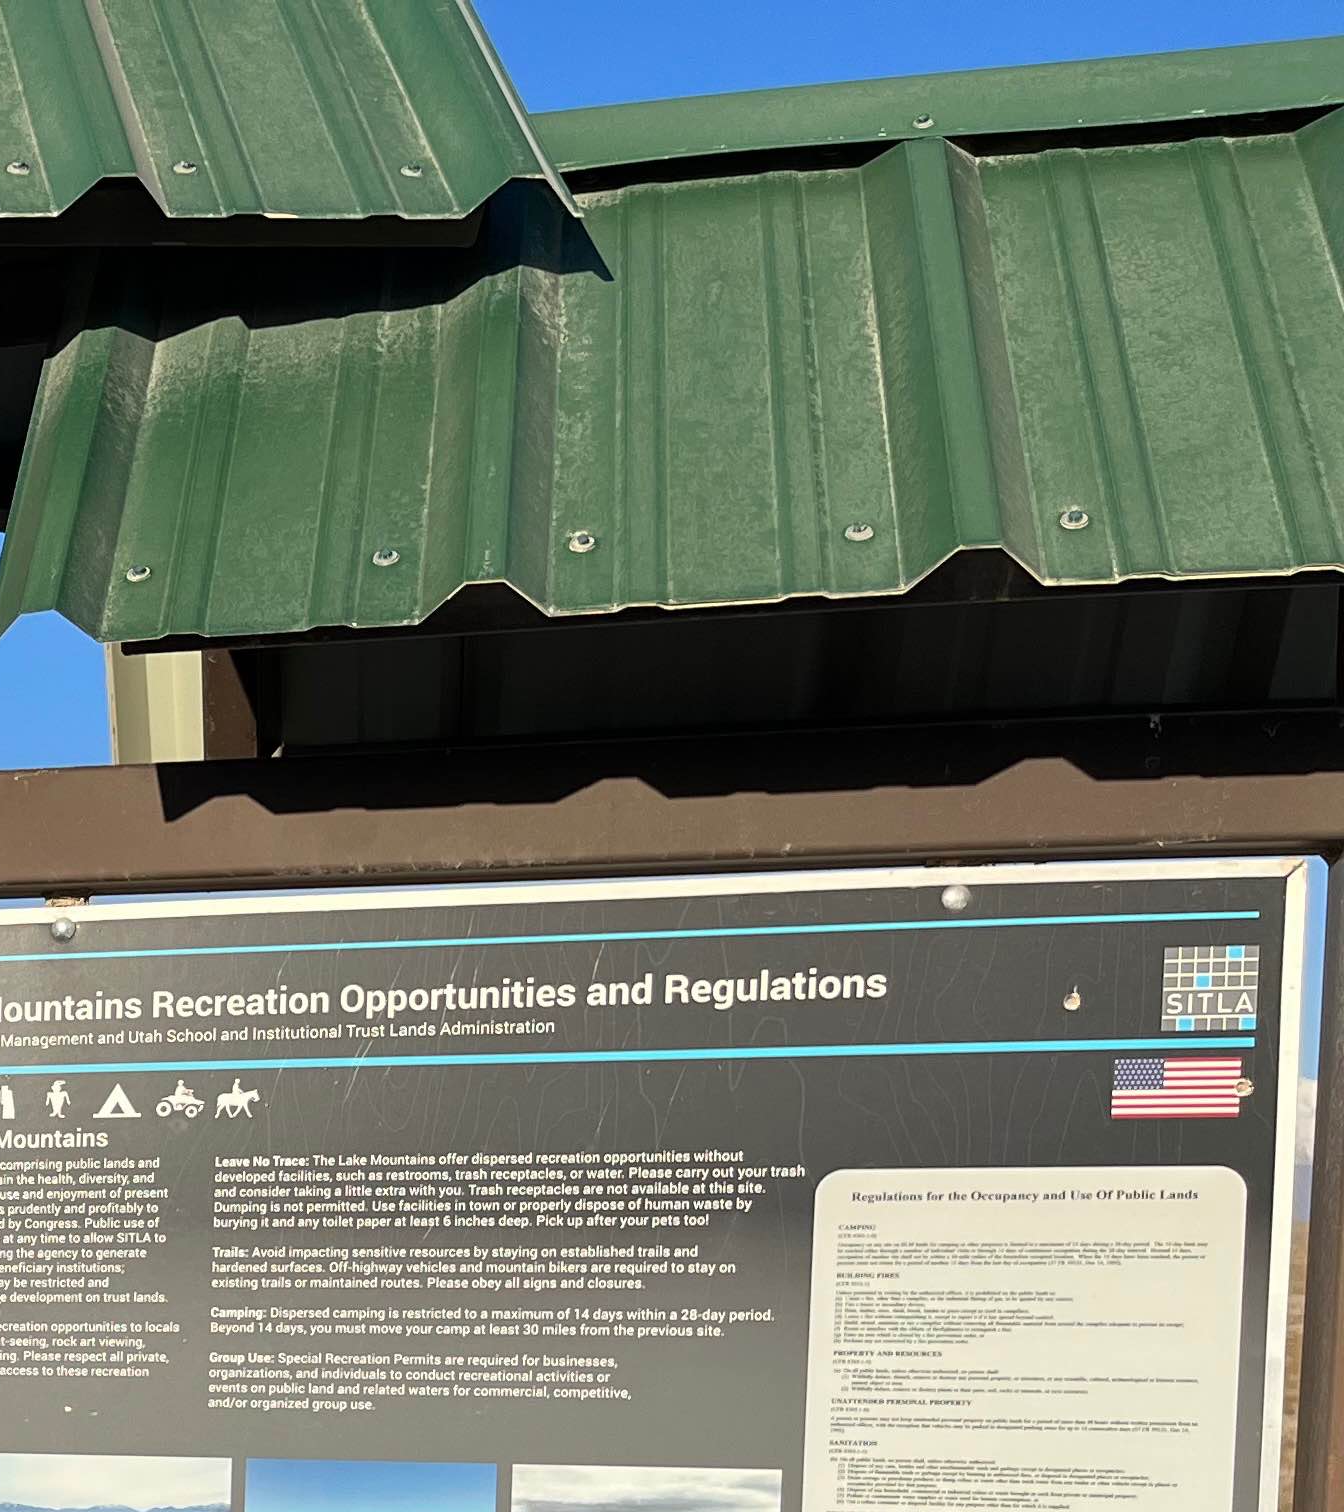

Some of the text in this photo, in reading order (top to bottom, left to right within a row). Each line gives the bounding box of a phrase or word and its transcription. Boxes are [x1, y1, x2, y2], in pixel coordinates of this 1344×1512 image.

[153, 985, 329, 1018] Recreation
[341, 975, 575, 1017] Opportunities
[587, 972, 652, 1006] and
[665, 967, 886, 1009] Regulations
[1166, 992, 1254, 1016] SITLA
[1, 1032, 93, 1049] Management
[98, 1030, 124, 1045] and
[129, 1029, 162, 1044] Utah
[167, 1028, 216, 1043] School
[221, 1026, 248, 1042] and
[253, 1023, 341, 1041] Institutional
[346, 1024, 384, 1038] Trust
[390, 1021, 436, 1037] Lands
[440, 1017, 554, 1036] Administration
[215, 1149, 743, 1167] Leave No Trace: The Lake Mountains offer dispersed recreation opportunities without
[852, 1190, 1198, 1204] Regulations for the Occupancy and Use Of Public Lands
